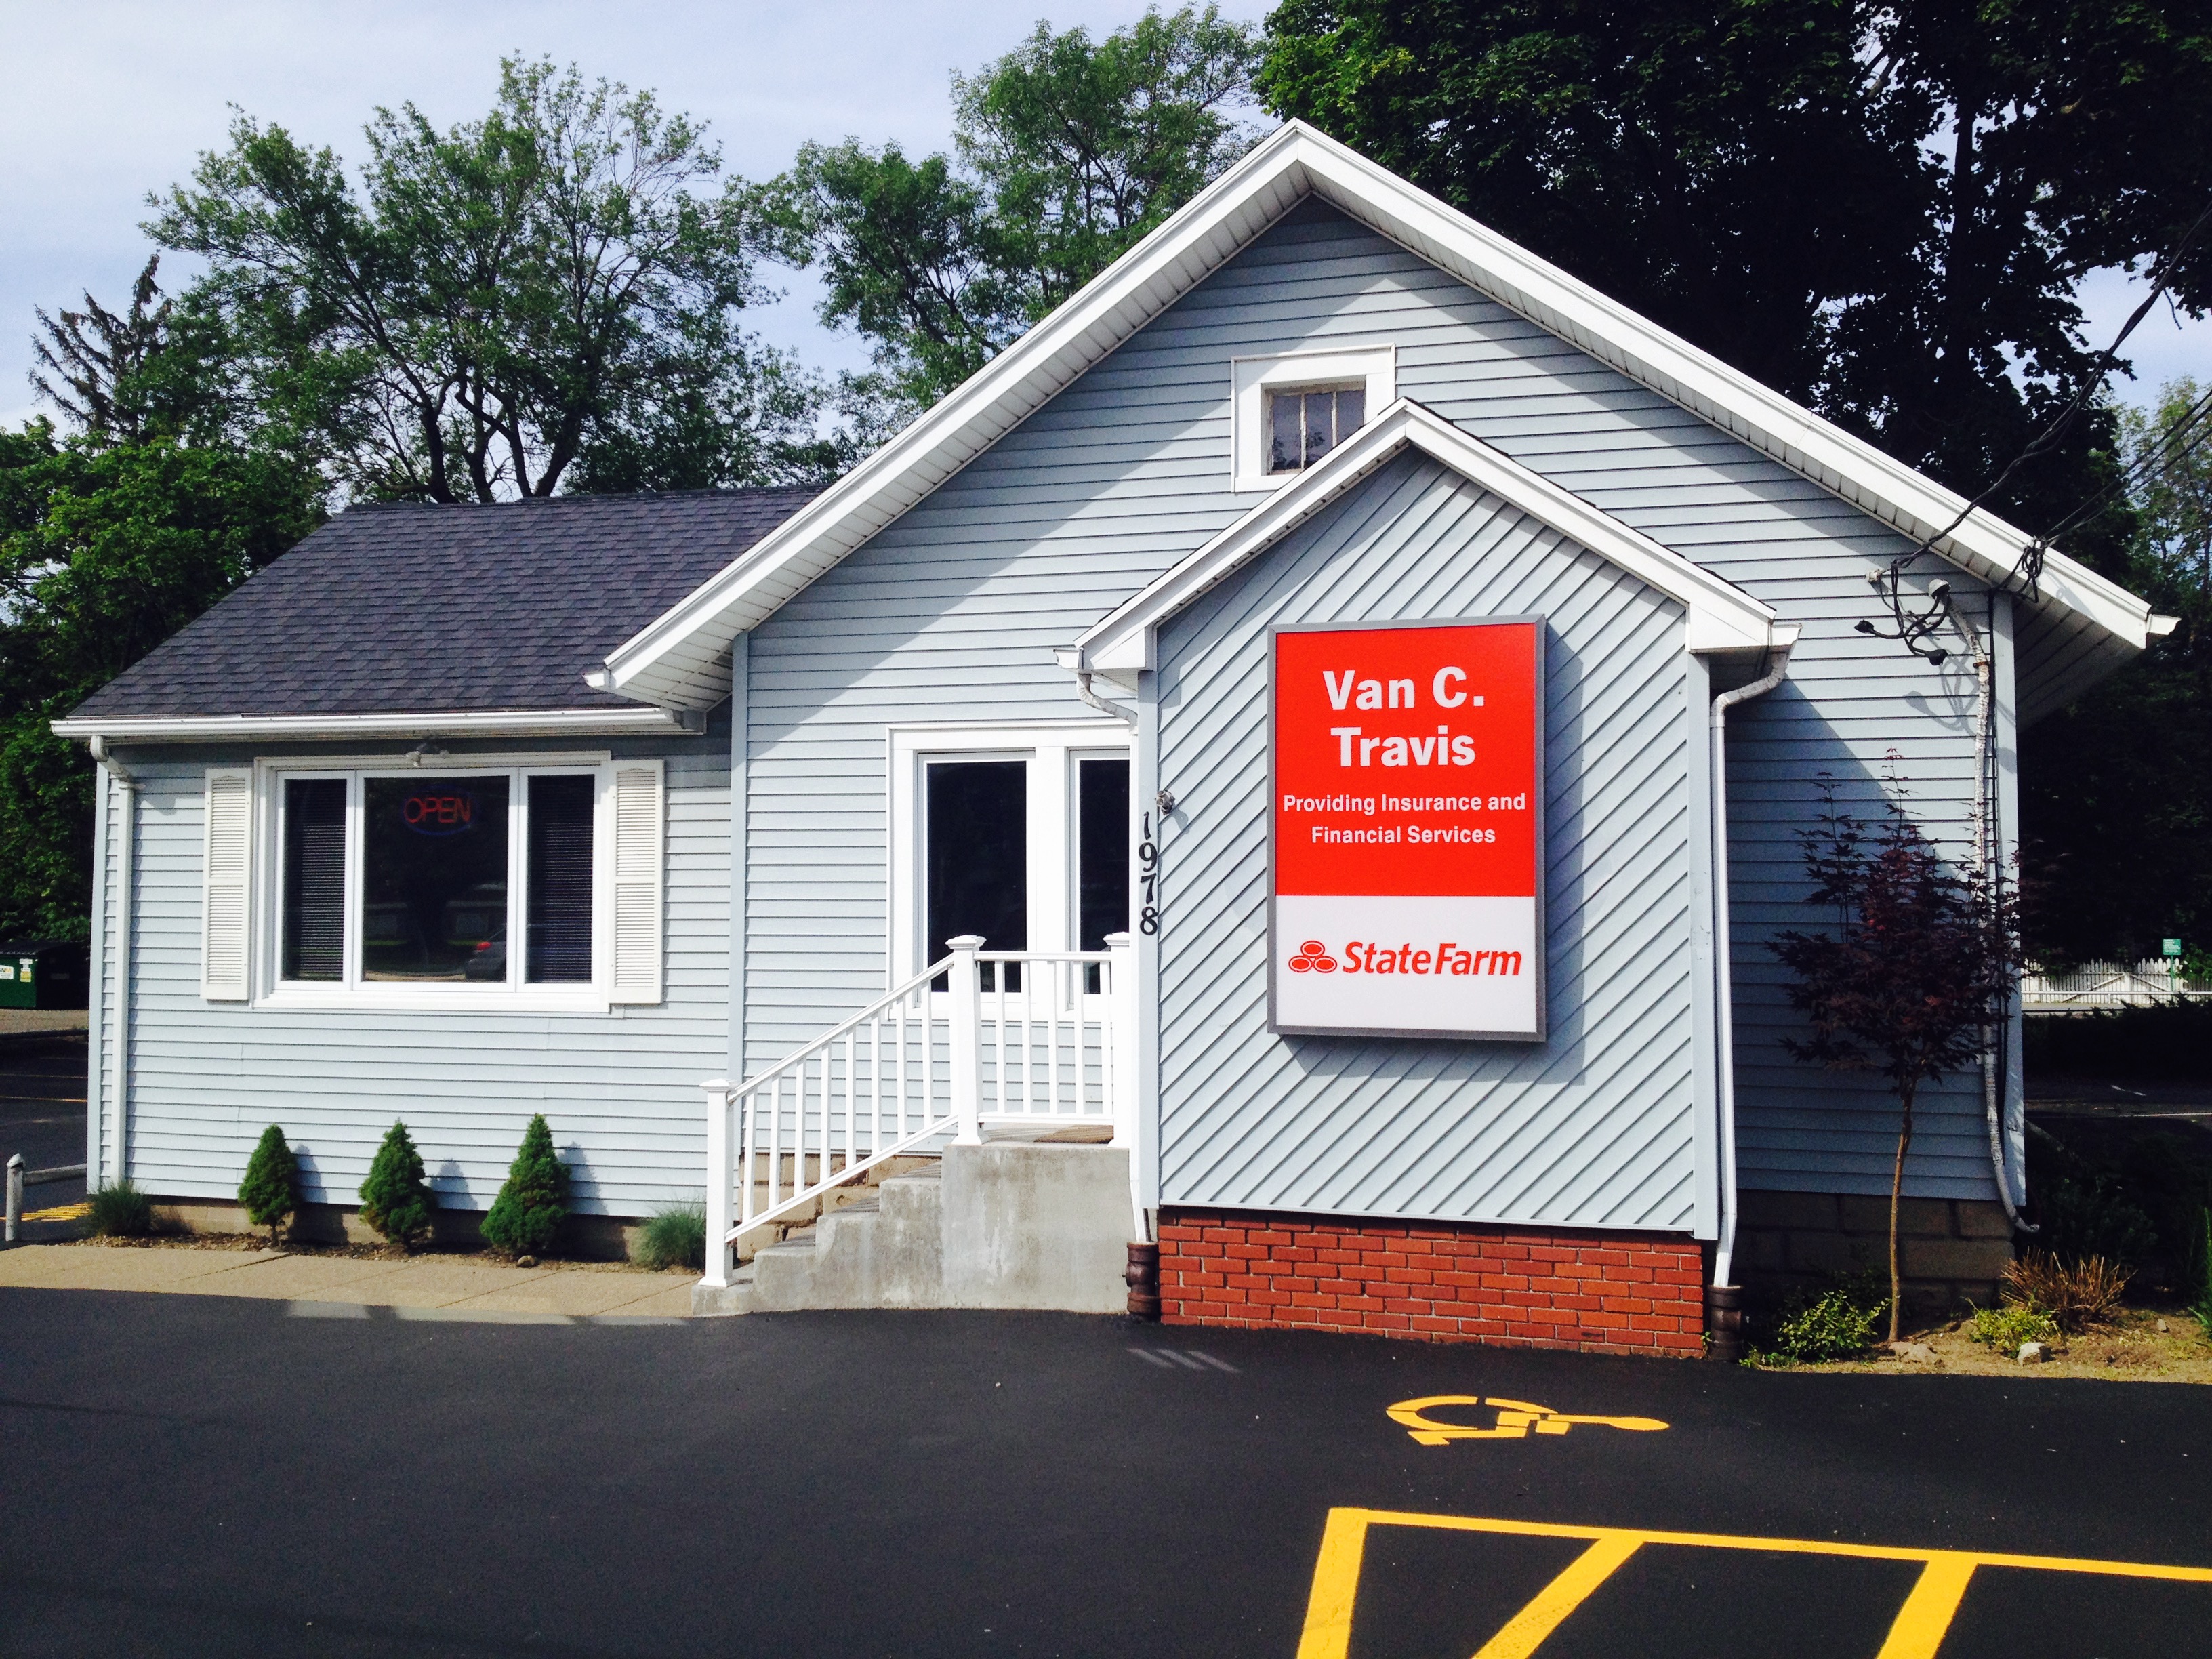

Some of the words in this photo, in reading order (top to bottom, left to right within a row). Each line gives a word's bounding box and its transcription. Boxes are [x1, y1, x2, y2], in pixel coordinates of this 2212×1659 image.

[1322, 670, 1415, 710] Van
[1432, 666, 1484, 708] C.
[1330, 724, 1475, 767] Travis
[404, 797, 472, 823] OPEN
[1284, 794, 1375, 816] Providing
[1382, 794, 1482, 811] Insurance
[1488, 792, 1525, 811] and
[1311, 825, 1401, 844] Financial
[1407, 825, 1496, 844] Services
[1139, 811, 1158, 935] 1978
